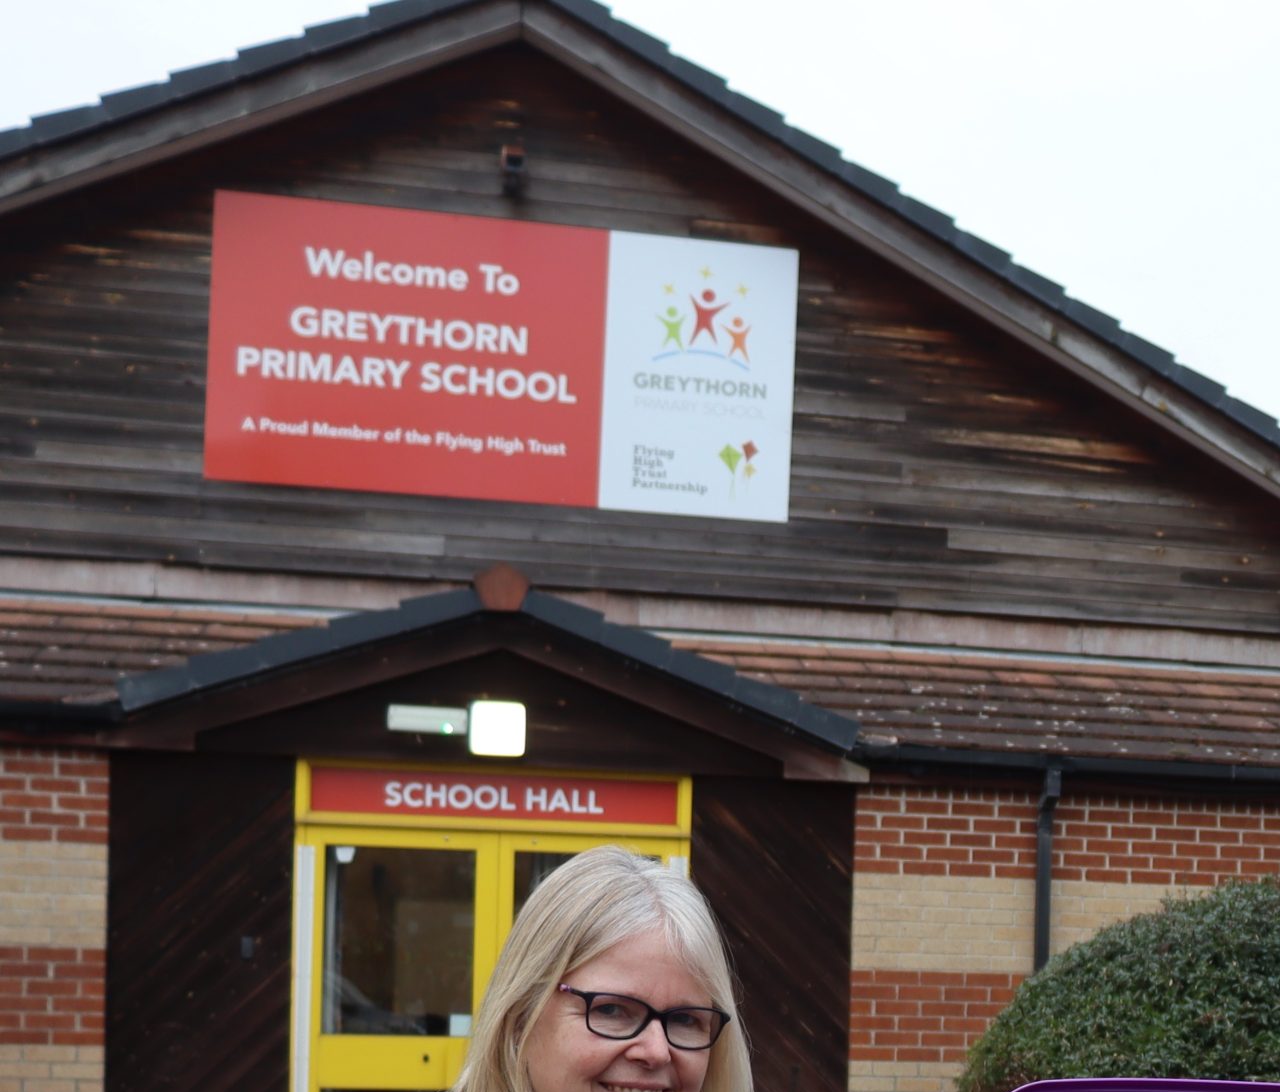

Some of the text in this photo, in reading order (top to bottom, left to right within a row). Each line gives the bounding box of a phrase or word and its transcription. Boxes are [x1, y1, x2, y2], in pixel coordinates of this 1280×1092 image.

[305, 246, 520, 296] Welcome To
[289, 306, 529, 356] GREYTHORN
[236, 346, 577, 404] PRIMARY SCHOOL
[633, 372, 768, 400] GREYTHORN
[242, 417, 567, 457] A Proud Member of the Flying High Trust
[633, 444, 675, 460] Flying
[633, 455, 664, 469] High
[632, 477, 708, 496] Partnership
[384, 781, 604, 814] SCHOOL HALL
